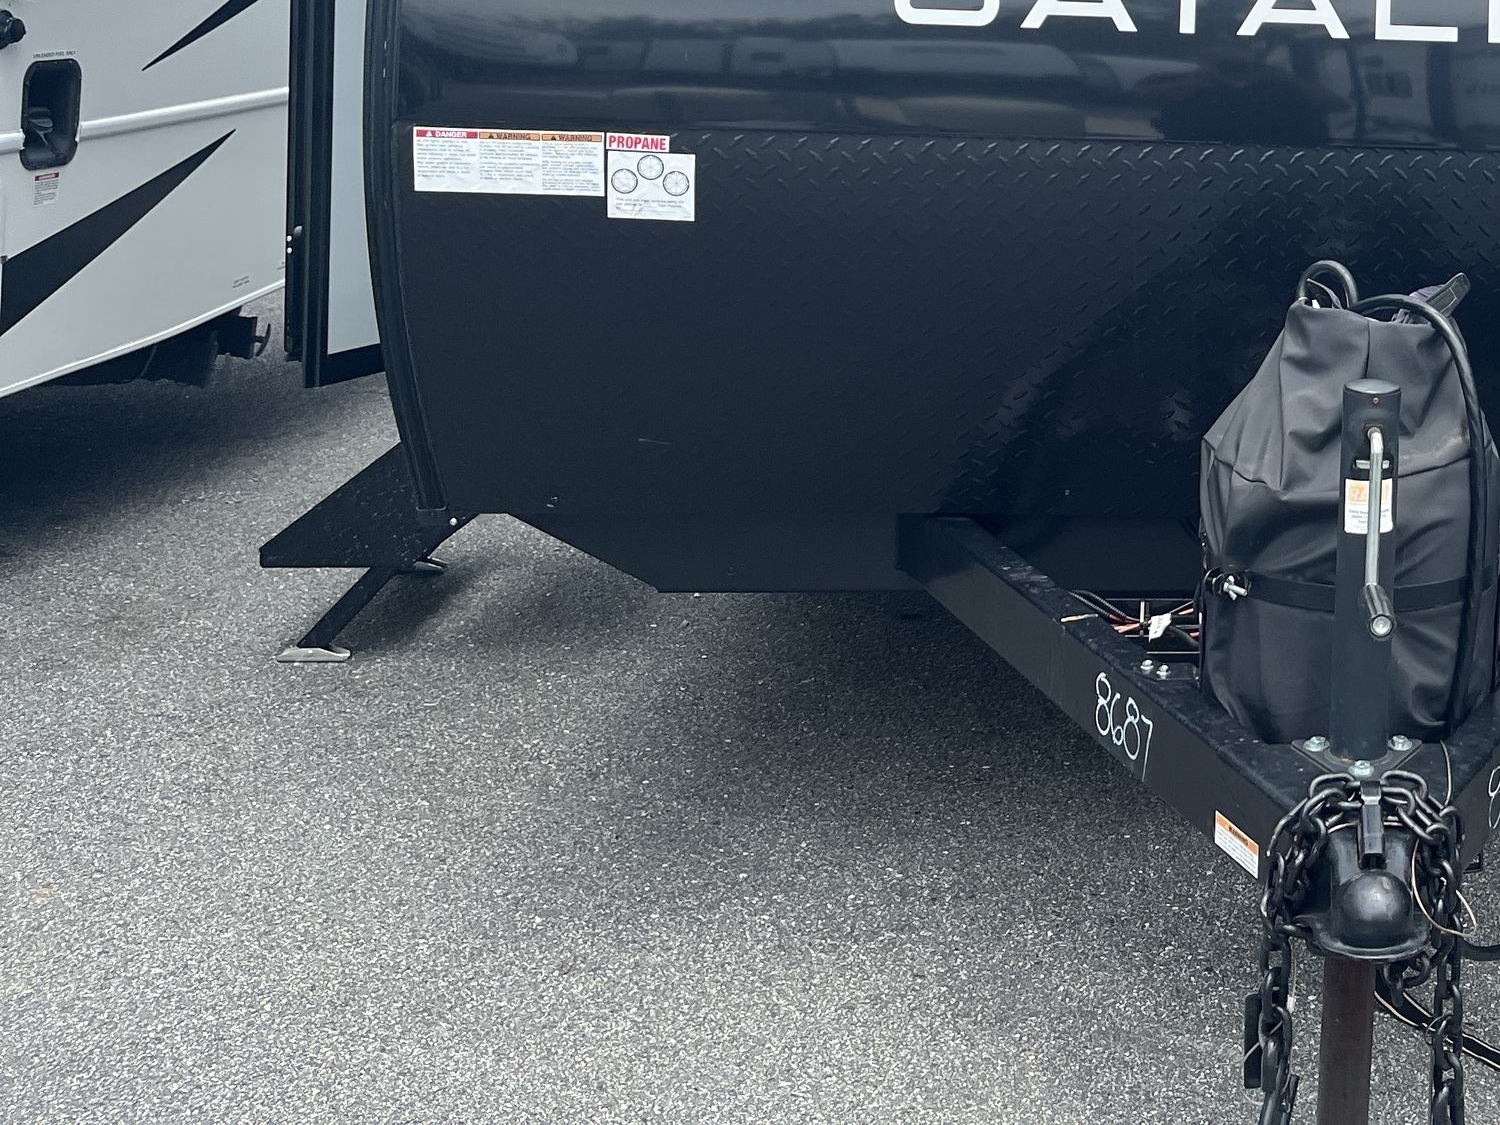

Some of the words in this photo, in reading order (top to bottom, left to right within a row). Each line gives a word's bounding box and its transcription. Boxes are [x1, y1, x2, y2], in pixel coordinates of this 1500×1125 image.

[435, 130, 468, 139] DANGER
[496, 132, 531, 140] WARNING
[558, 134, 592, 142] WARNING
[608, 135, 667, 151] PROPANE
[1096, 672, 1153, 783] 8687
